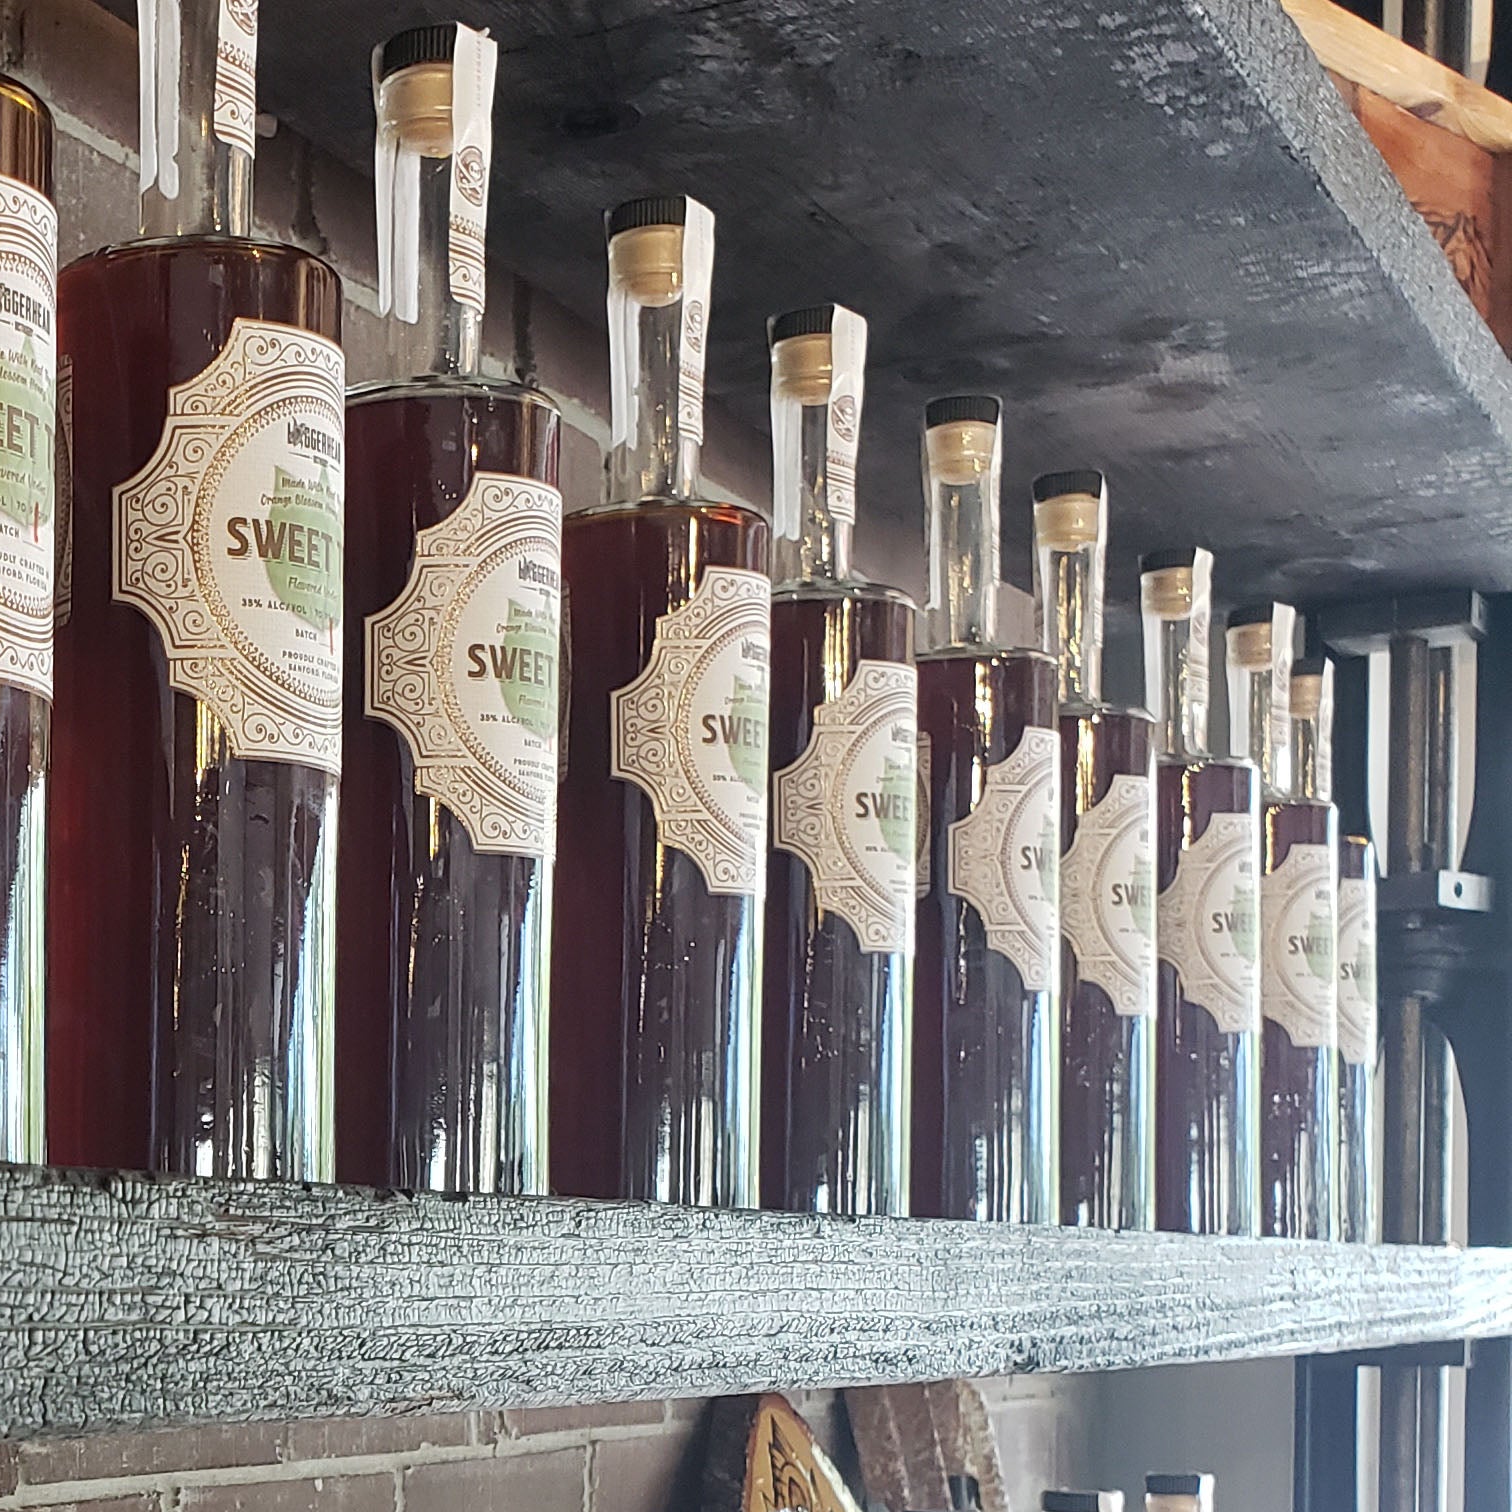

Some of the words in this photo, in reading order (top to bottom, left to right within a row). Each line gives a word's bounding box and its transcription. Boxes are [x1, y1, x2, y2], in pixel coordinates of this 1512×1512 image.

[8, 349, 28, 367] With
[287, 416, 341, 464] LGGERHEAD
[227, 517, 333, 573] SWEET
[19, 556, 45, 576] CRAFTED
[242, 598, 263, 608] 35%
[467, 643, 554, 689] SWEET
